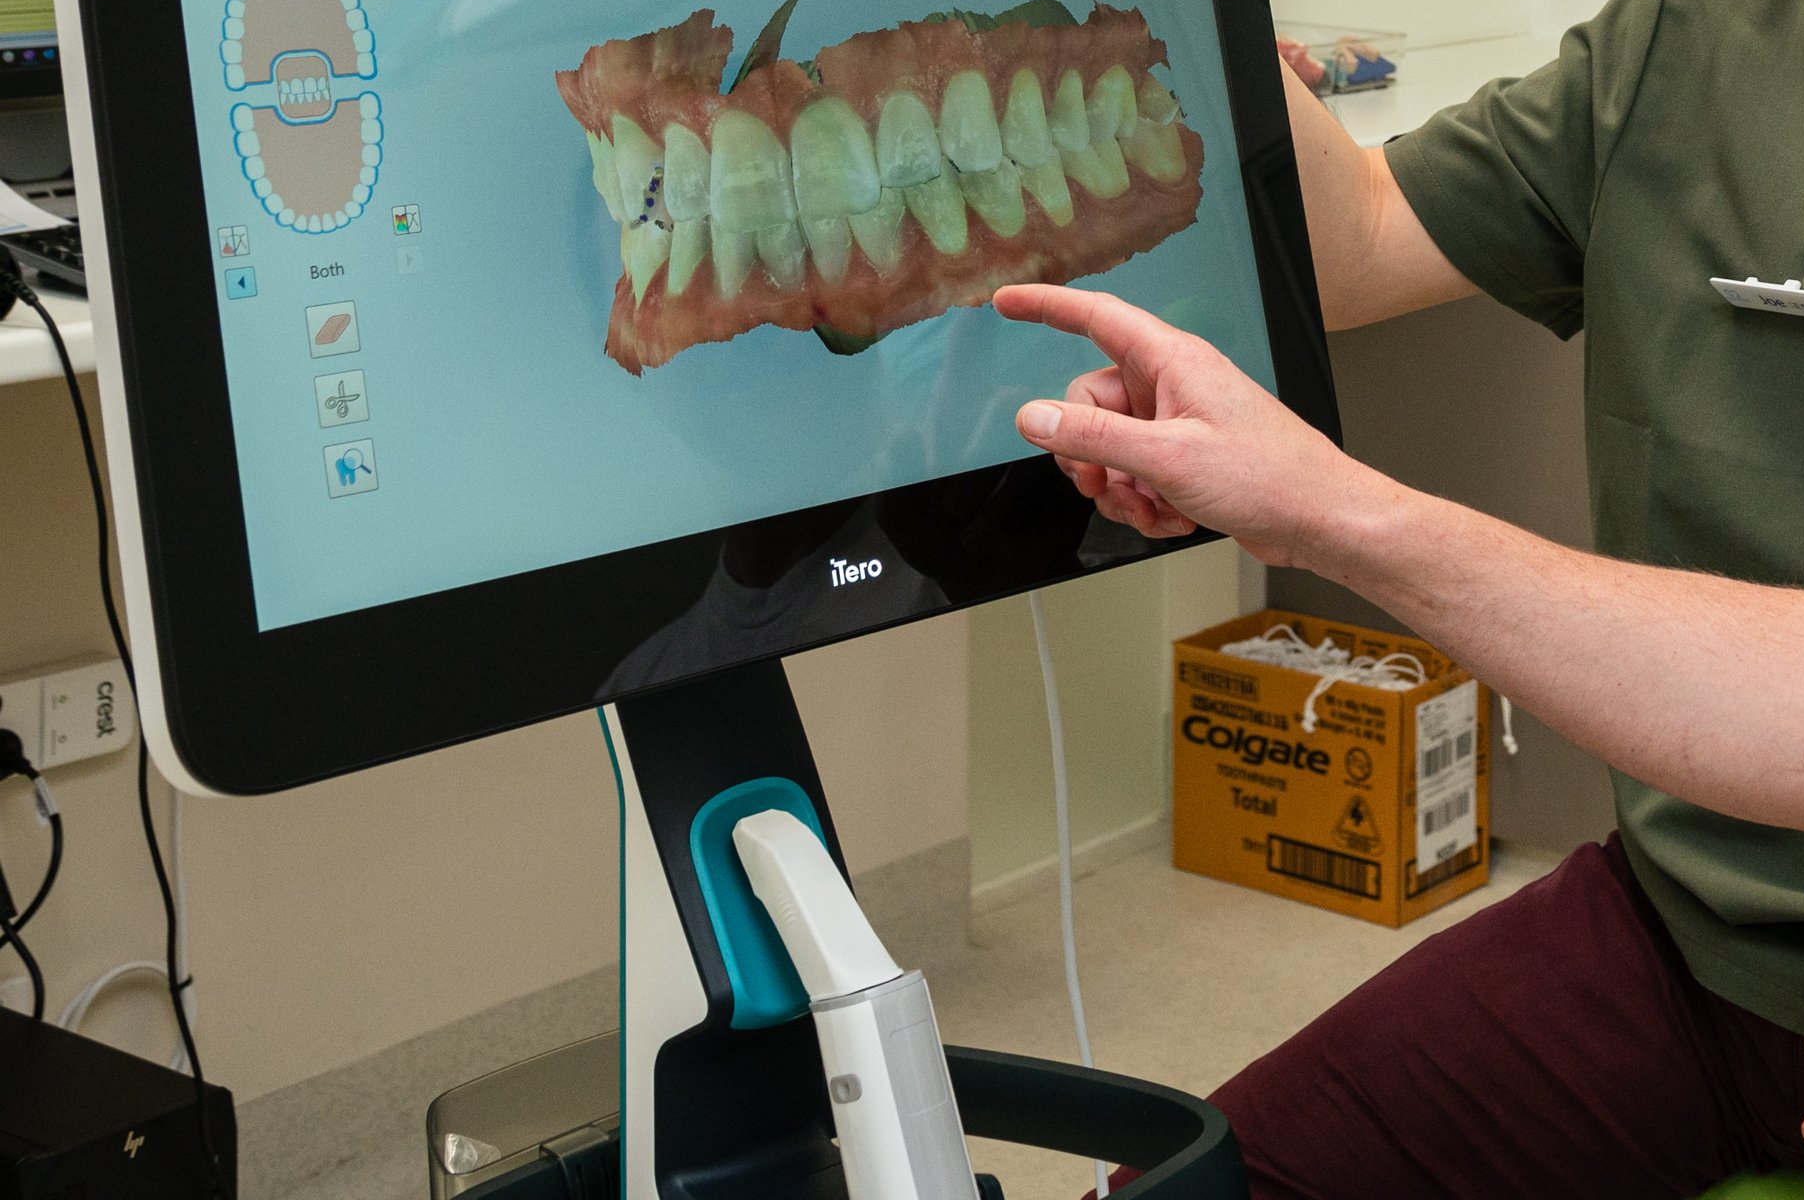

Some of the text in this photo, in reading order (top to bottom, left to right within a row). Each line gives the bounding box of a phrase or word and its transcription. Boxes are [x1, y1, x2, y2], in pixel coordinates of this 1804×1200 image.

[310, 261, 345, 280] Both
[1758, 294, 1787, 308] Joe
[829, 558, 882, 587] iTero
[1182, 714, 1331, 776] Colgate
[1230, 785, 1278, 817] Total
